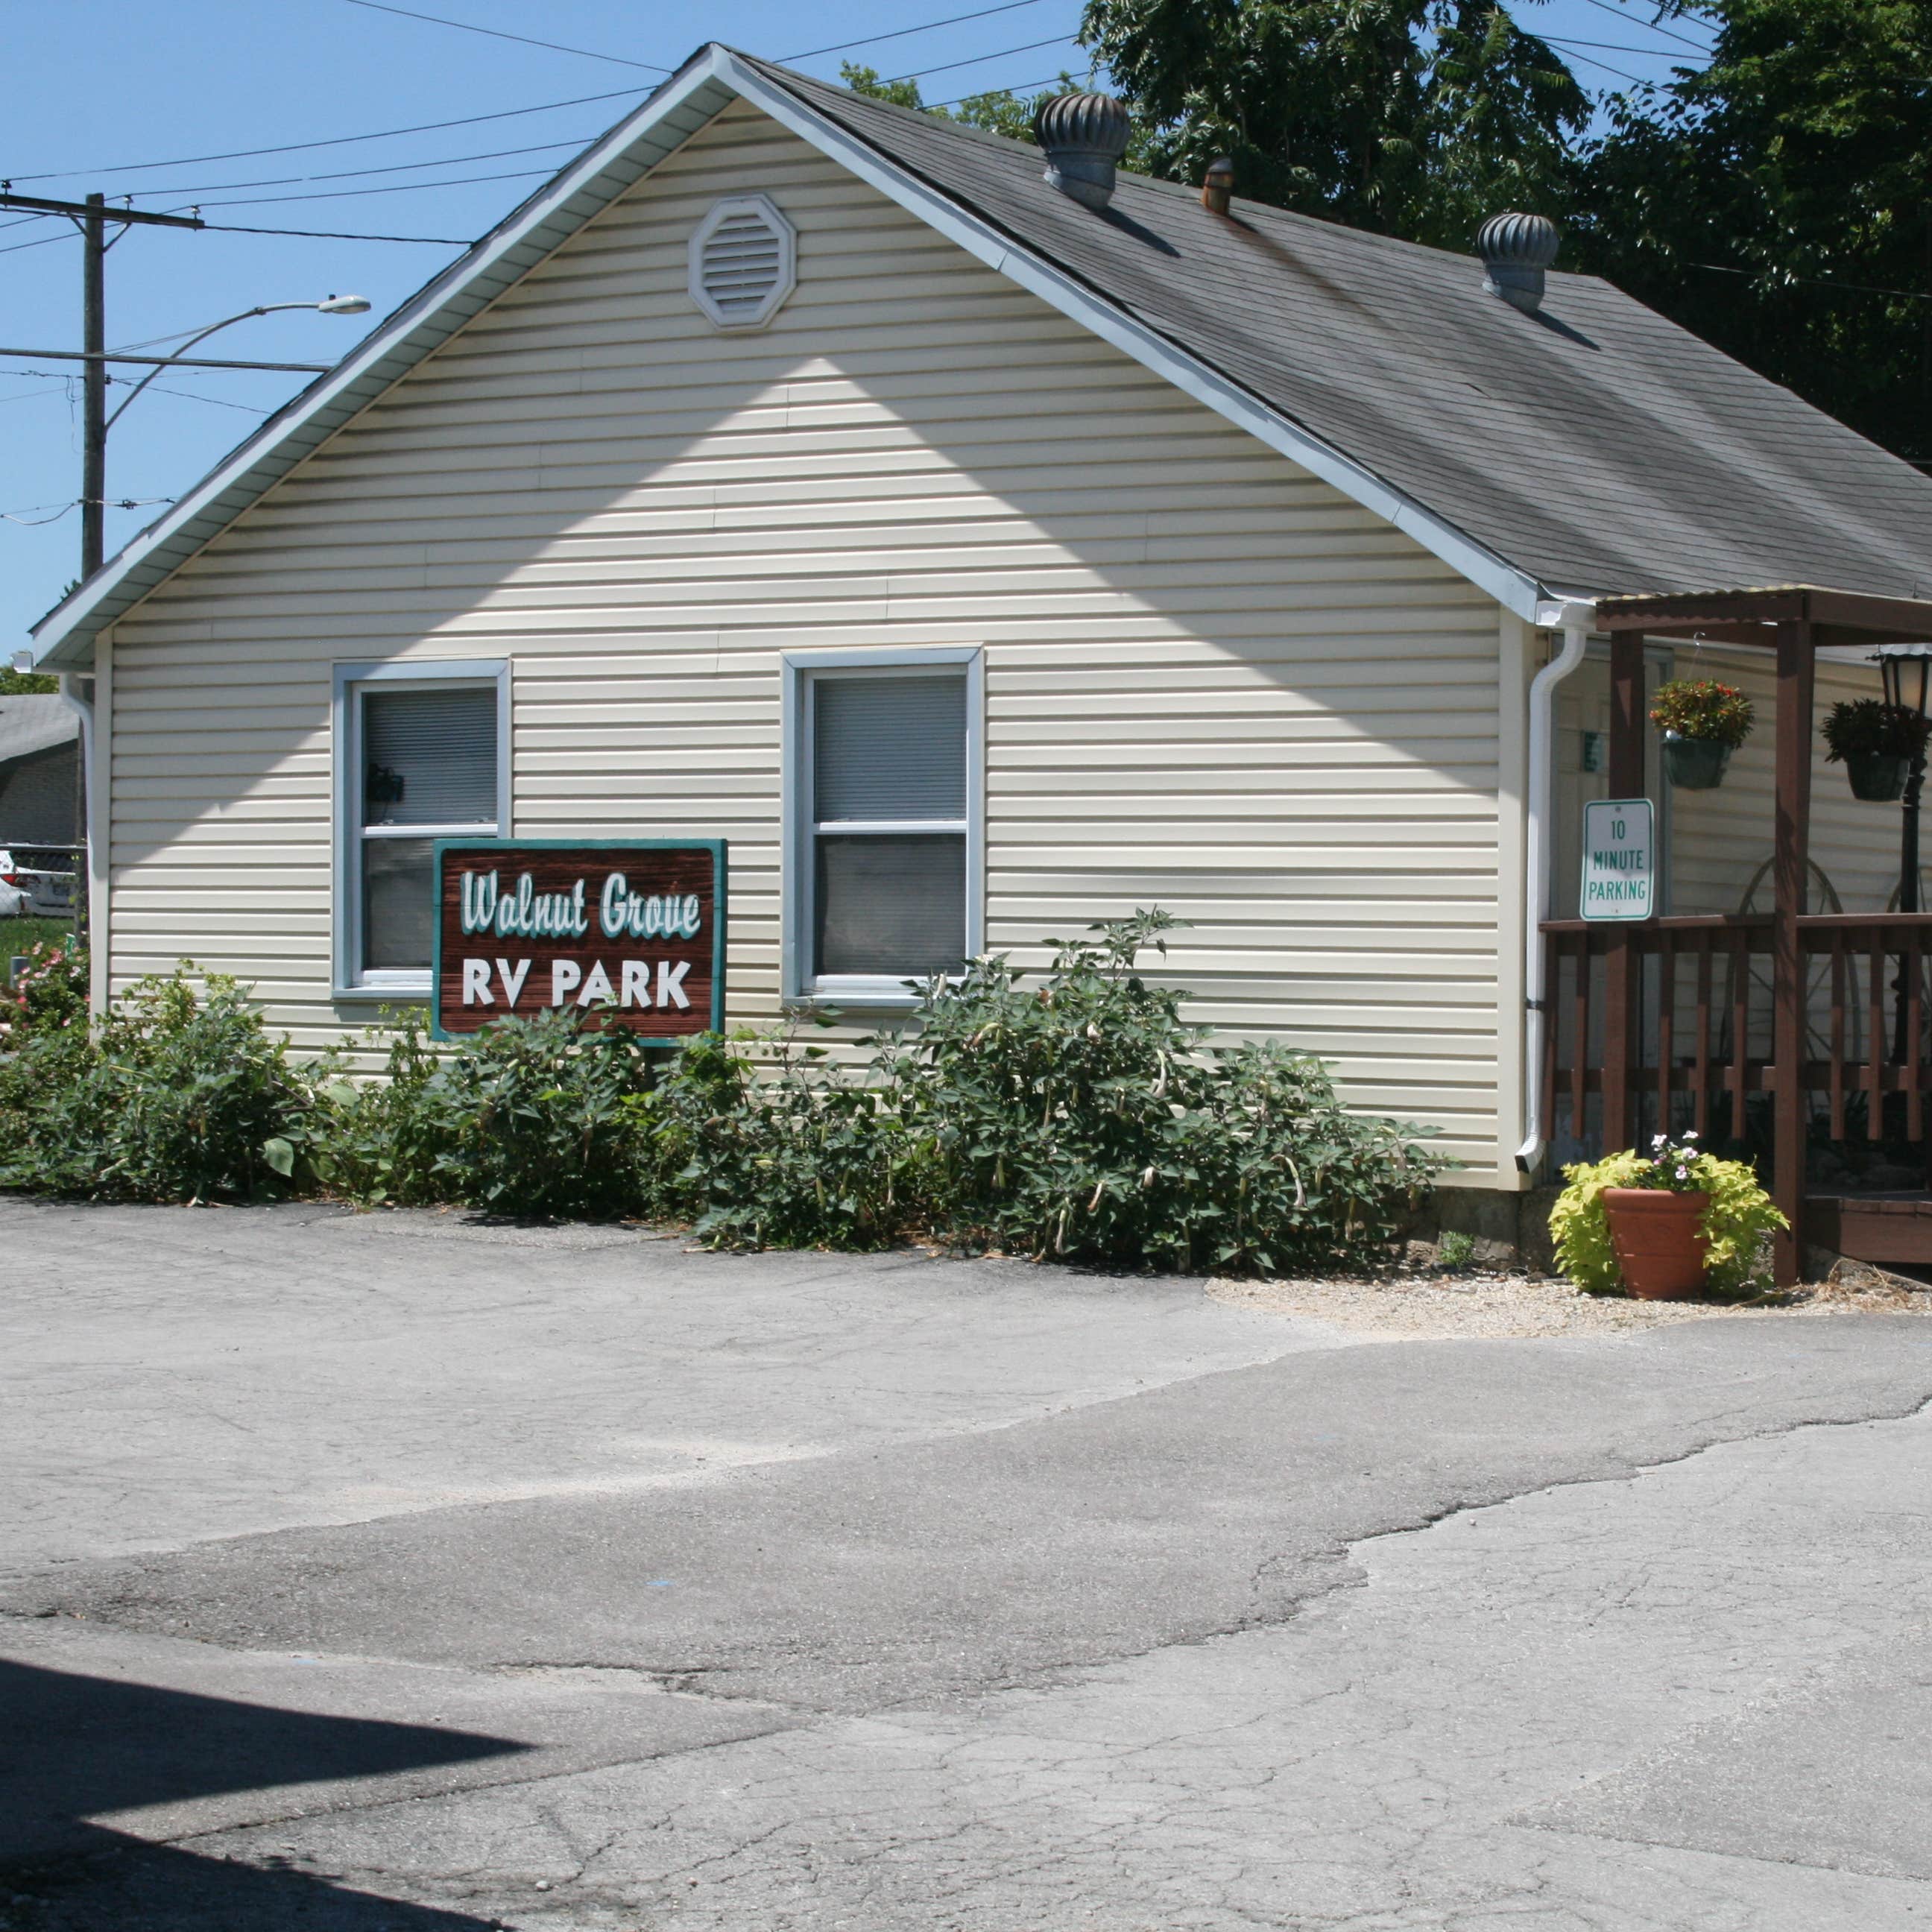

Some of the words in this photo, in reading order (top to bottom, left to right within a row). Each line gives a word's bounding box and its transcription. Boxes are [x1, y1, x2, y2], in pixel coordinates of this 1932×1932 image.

[1611, 820, 1626, 840] 10
[1594, 850, 1644, 871] MINUTE
[1588, 881, 1646, 900] PARKING
[460, 870, 588, 938] Walnut
[599, 872, 702, 940] Grove
[463, 959, 531, 1008] RV
[552, 959, 692, 1009] PARK
